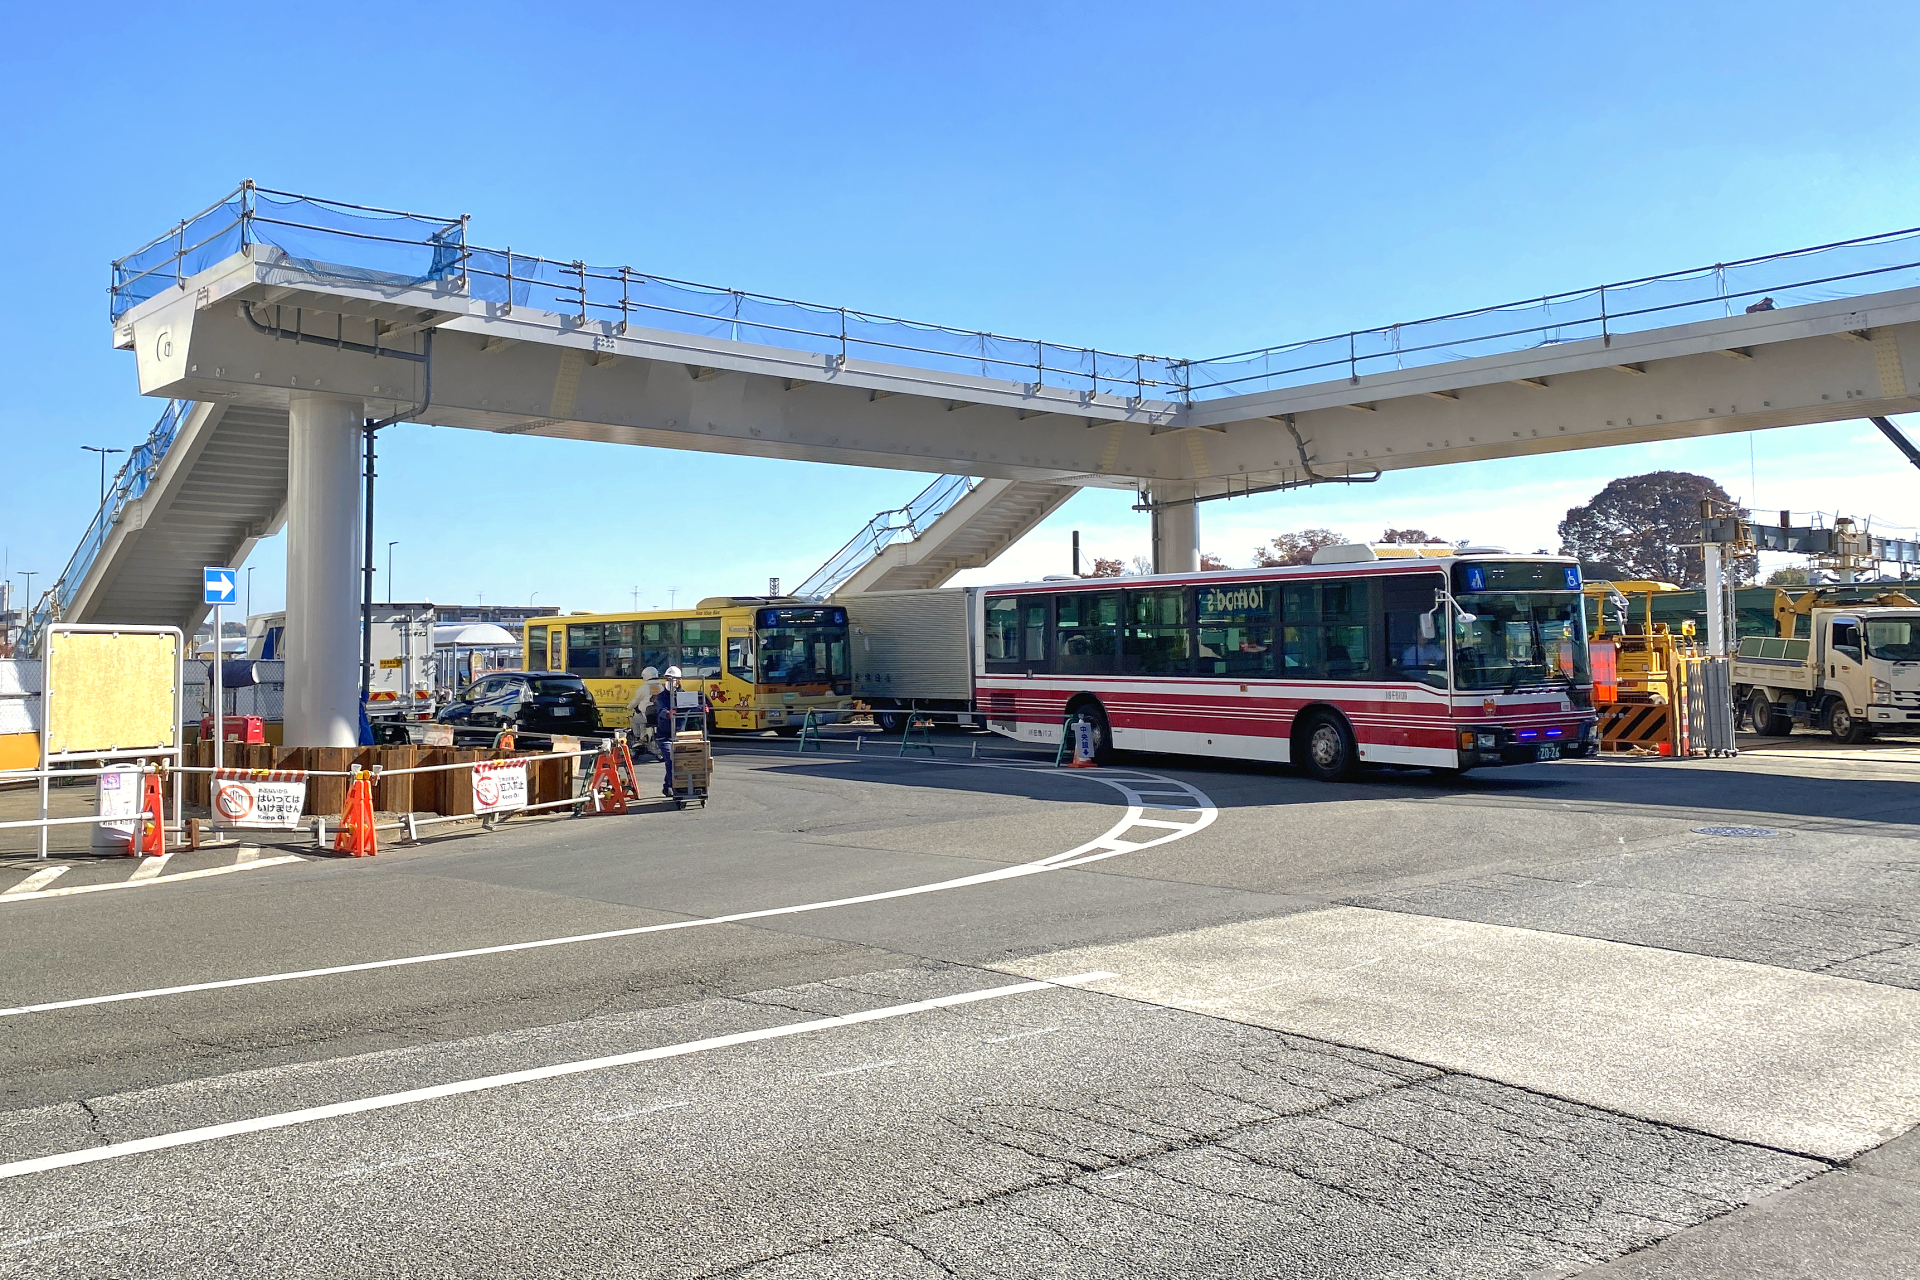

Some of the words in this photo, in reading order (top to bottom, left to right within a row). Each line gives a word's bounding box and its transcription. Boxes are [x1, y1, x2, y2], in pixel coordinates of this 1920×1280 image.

[257, 794, 300, 804] はいっては
[257, 804, 300, 813] いけません
